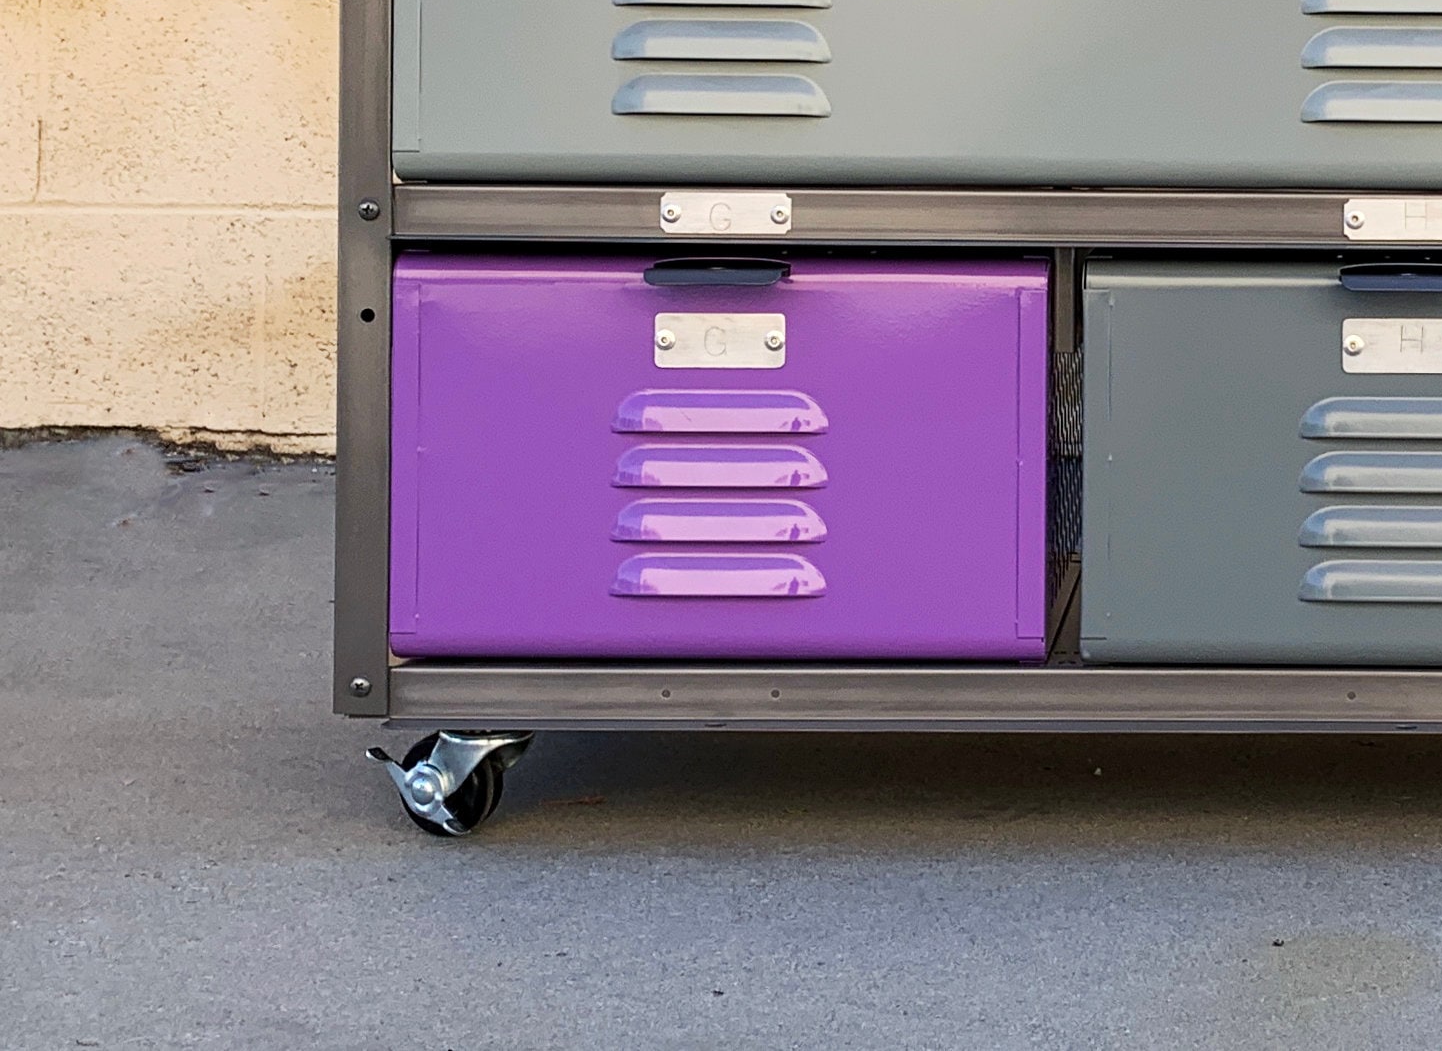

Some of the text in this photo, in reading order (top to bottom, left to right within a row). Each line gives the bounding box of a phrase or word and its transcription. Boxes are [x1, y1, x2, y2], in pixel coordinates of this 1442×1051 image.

[708, 202, 733, 232] G
[1404, 201, 1429, 231] H
[703, 325, 728, 357] G
[1399, 324, 1425, 355] H
